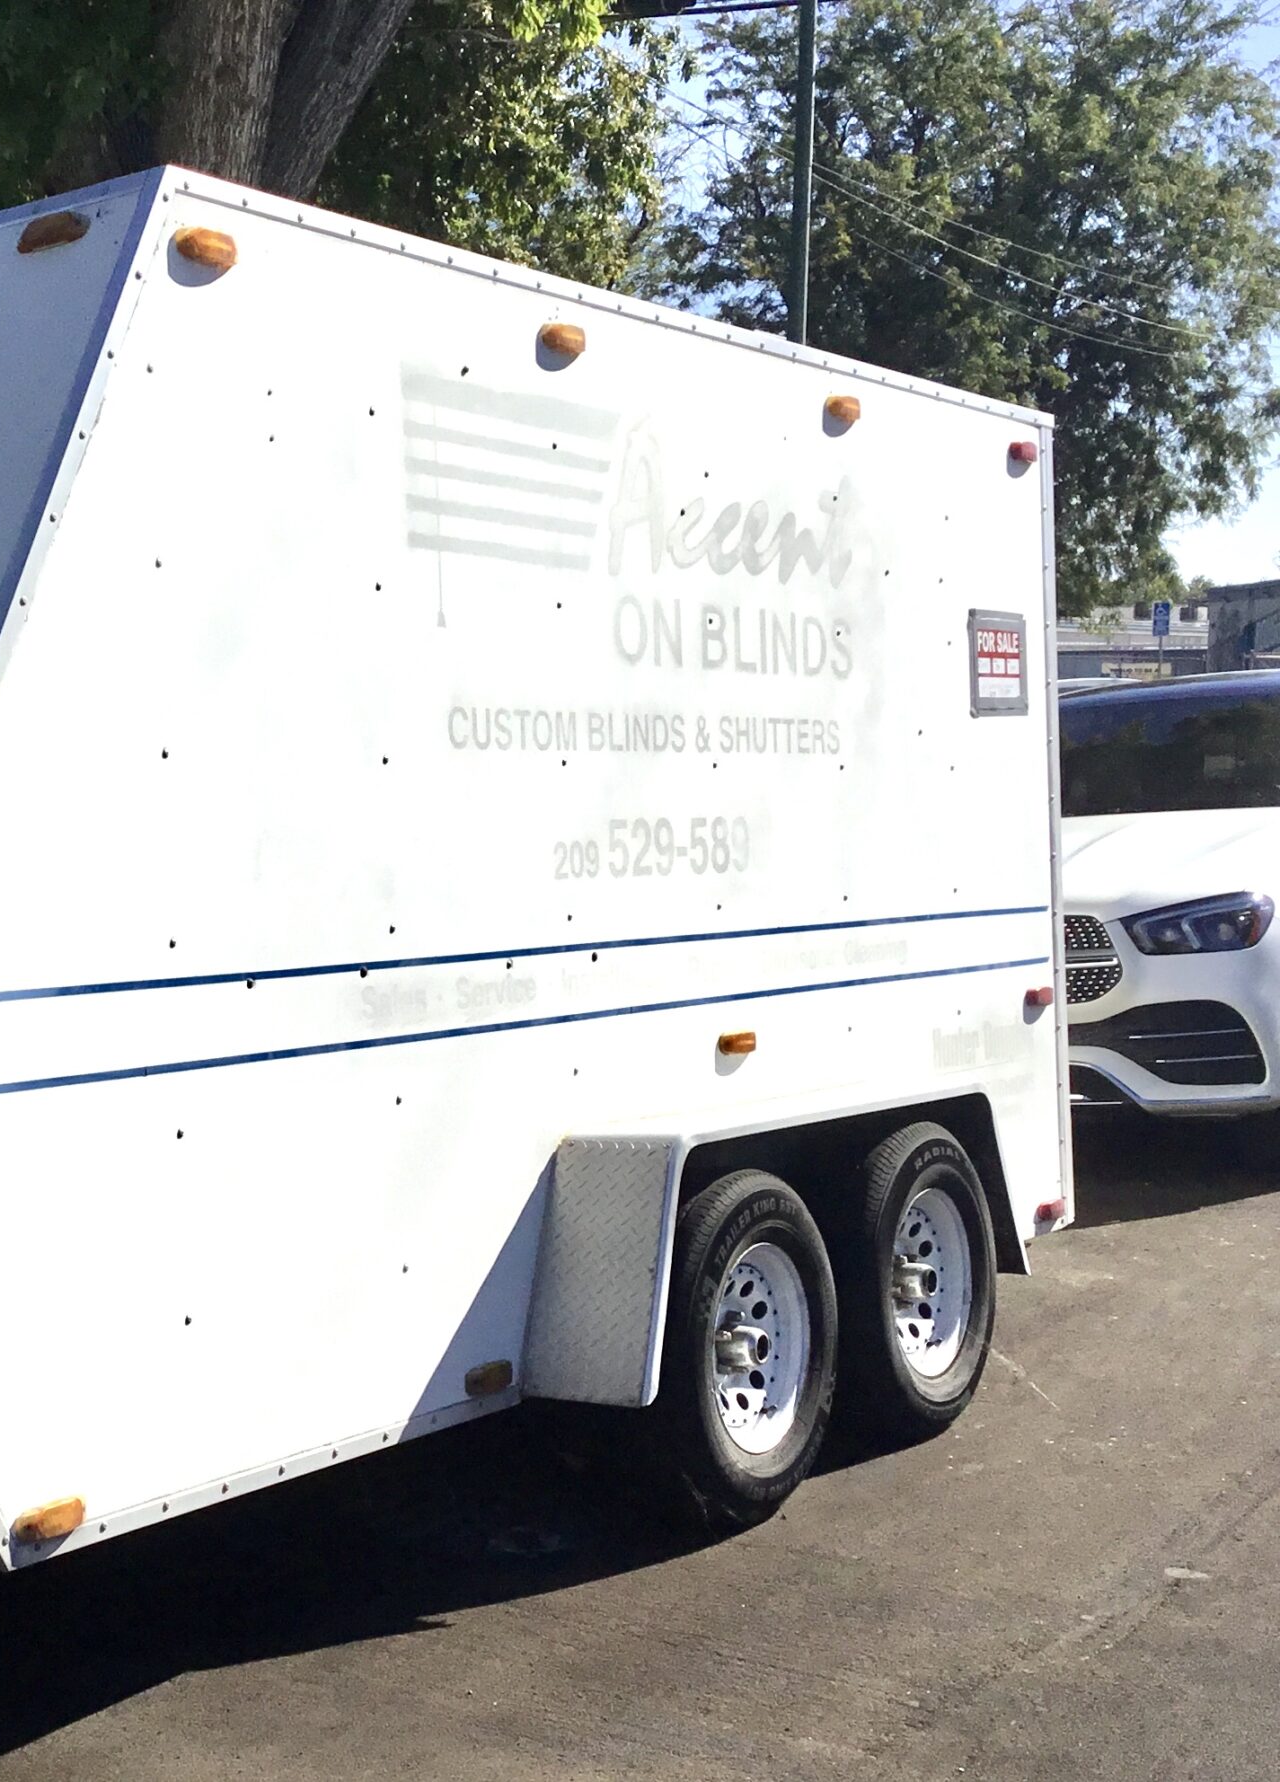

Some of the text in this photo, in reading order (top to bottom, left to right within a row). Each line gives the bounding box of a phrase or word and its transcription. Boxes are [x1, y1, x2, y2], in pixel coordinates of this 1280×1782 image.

[608, 412, 854, 588] Accent
[614, 595, 853, 681] ON BLINDS
[977, 631, 1019, 654] FOR SALE
[447, 705, 841, 756] CUSTOM BLINDS & SHUTTERS
[553, 840, 599, 880] 209
[456, 973, 537, 1010] Service
[914, 1146, 960, 1171] RADIAL
[714, 1209, 752, 1265] TRAILER
[752, 1198, 777, 1218] KING
